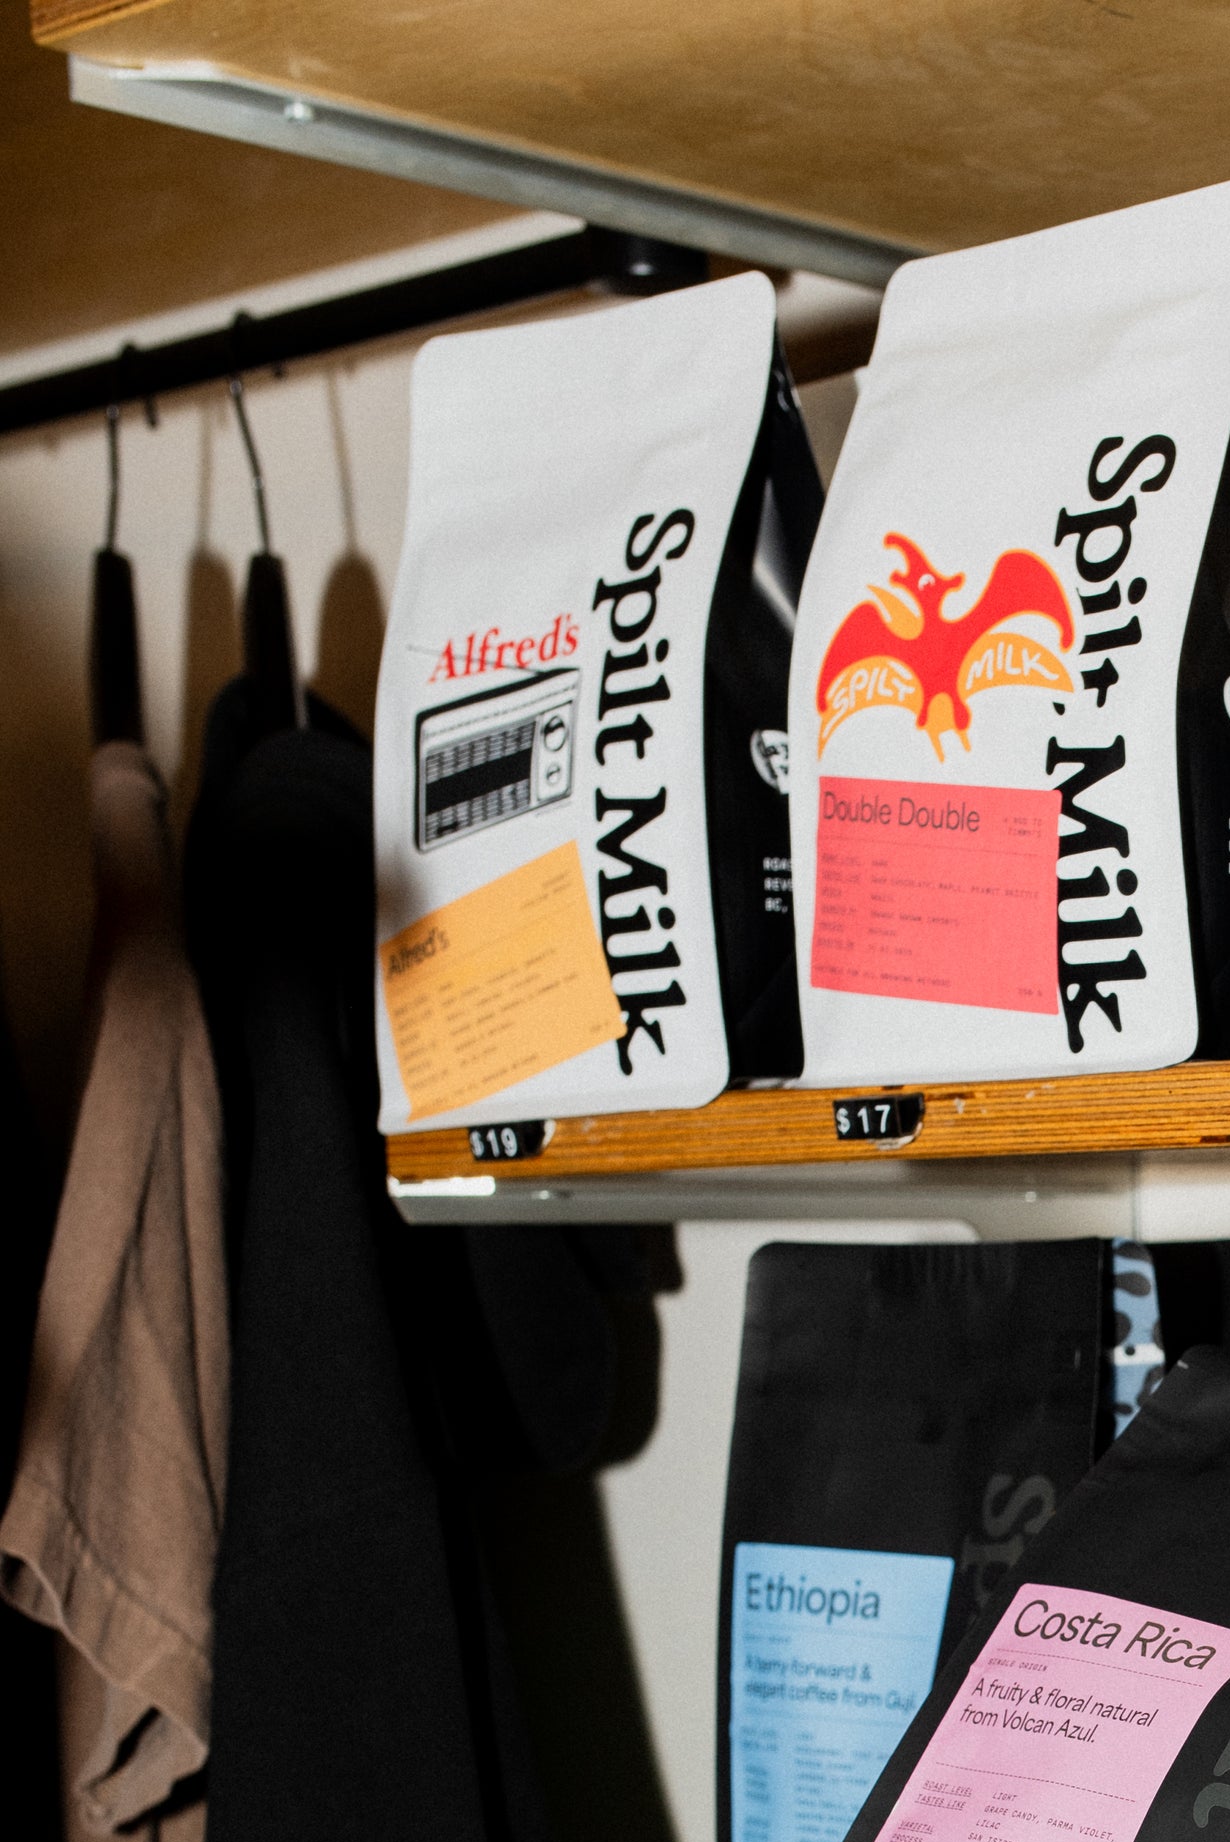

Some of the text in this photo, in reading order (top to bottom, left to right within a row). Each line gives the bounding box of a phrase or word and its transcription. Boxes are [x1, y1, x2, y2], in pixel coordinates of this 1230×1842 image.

[427, 613, 581, 683] Alfred's
[824, 643, 1059, 721] SPILT MILK
[1045, 434, 1177, 1054] Spilt Milk
[593, 508, 695, 1077] Spilt Milk
[822, 791, 891, 824] Double
[898, 797, 980, 832] Double
[470, 1127, 517, 1157] $19
[835, 1105, 892, 1135] $17
[745, 1572, 880, 1625] Ethiopia
[1014, 1599, 1217, 1670] Costa Rica
[960, 1705, 1098, 1743] from Volcan Azul.
[972, 1678, 1158, 1727] A fruity & floral natural
[992, 1792, 1017, 1802] LIGHT
[976, 1820, 1001, 1830] LILAC
[984, 1805, 1115, 1842] GRAPE CANDY, PARMA VIOLET,
